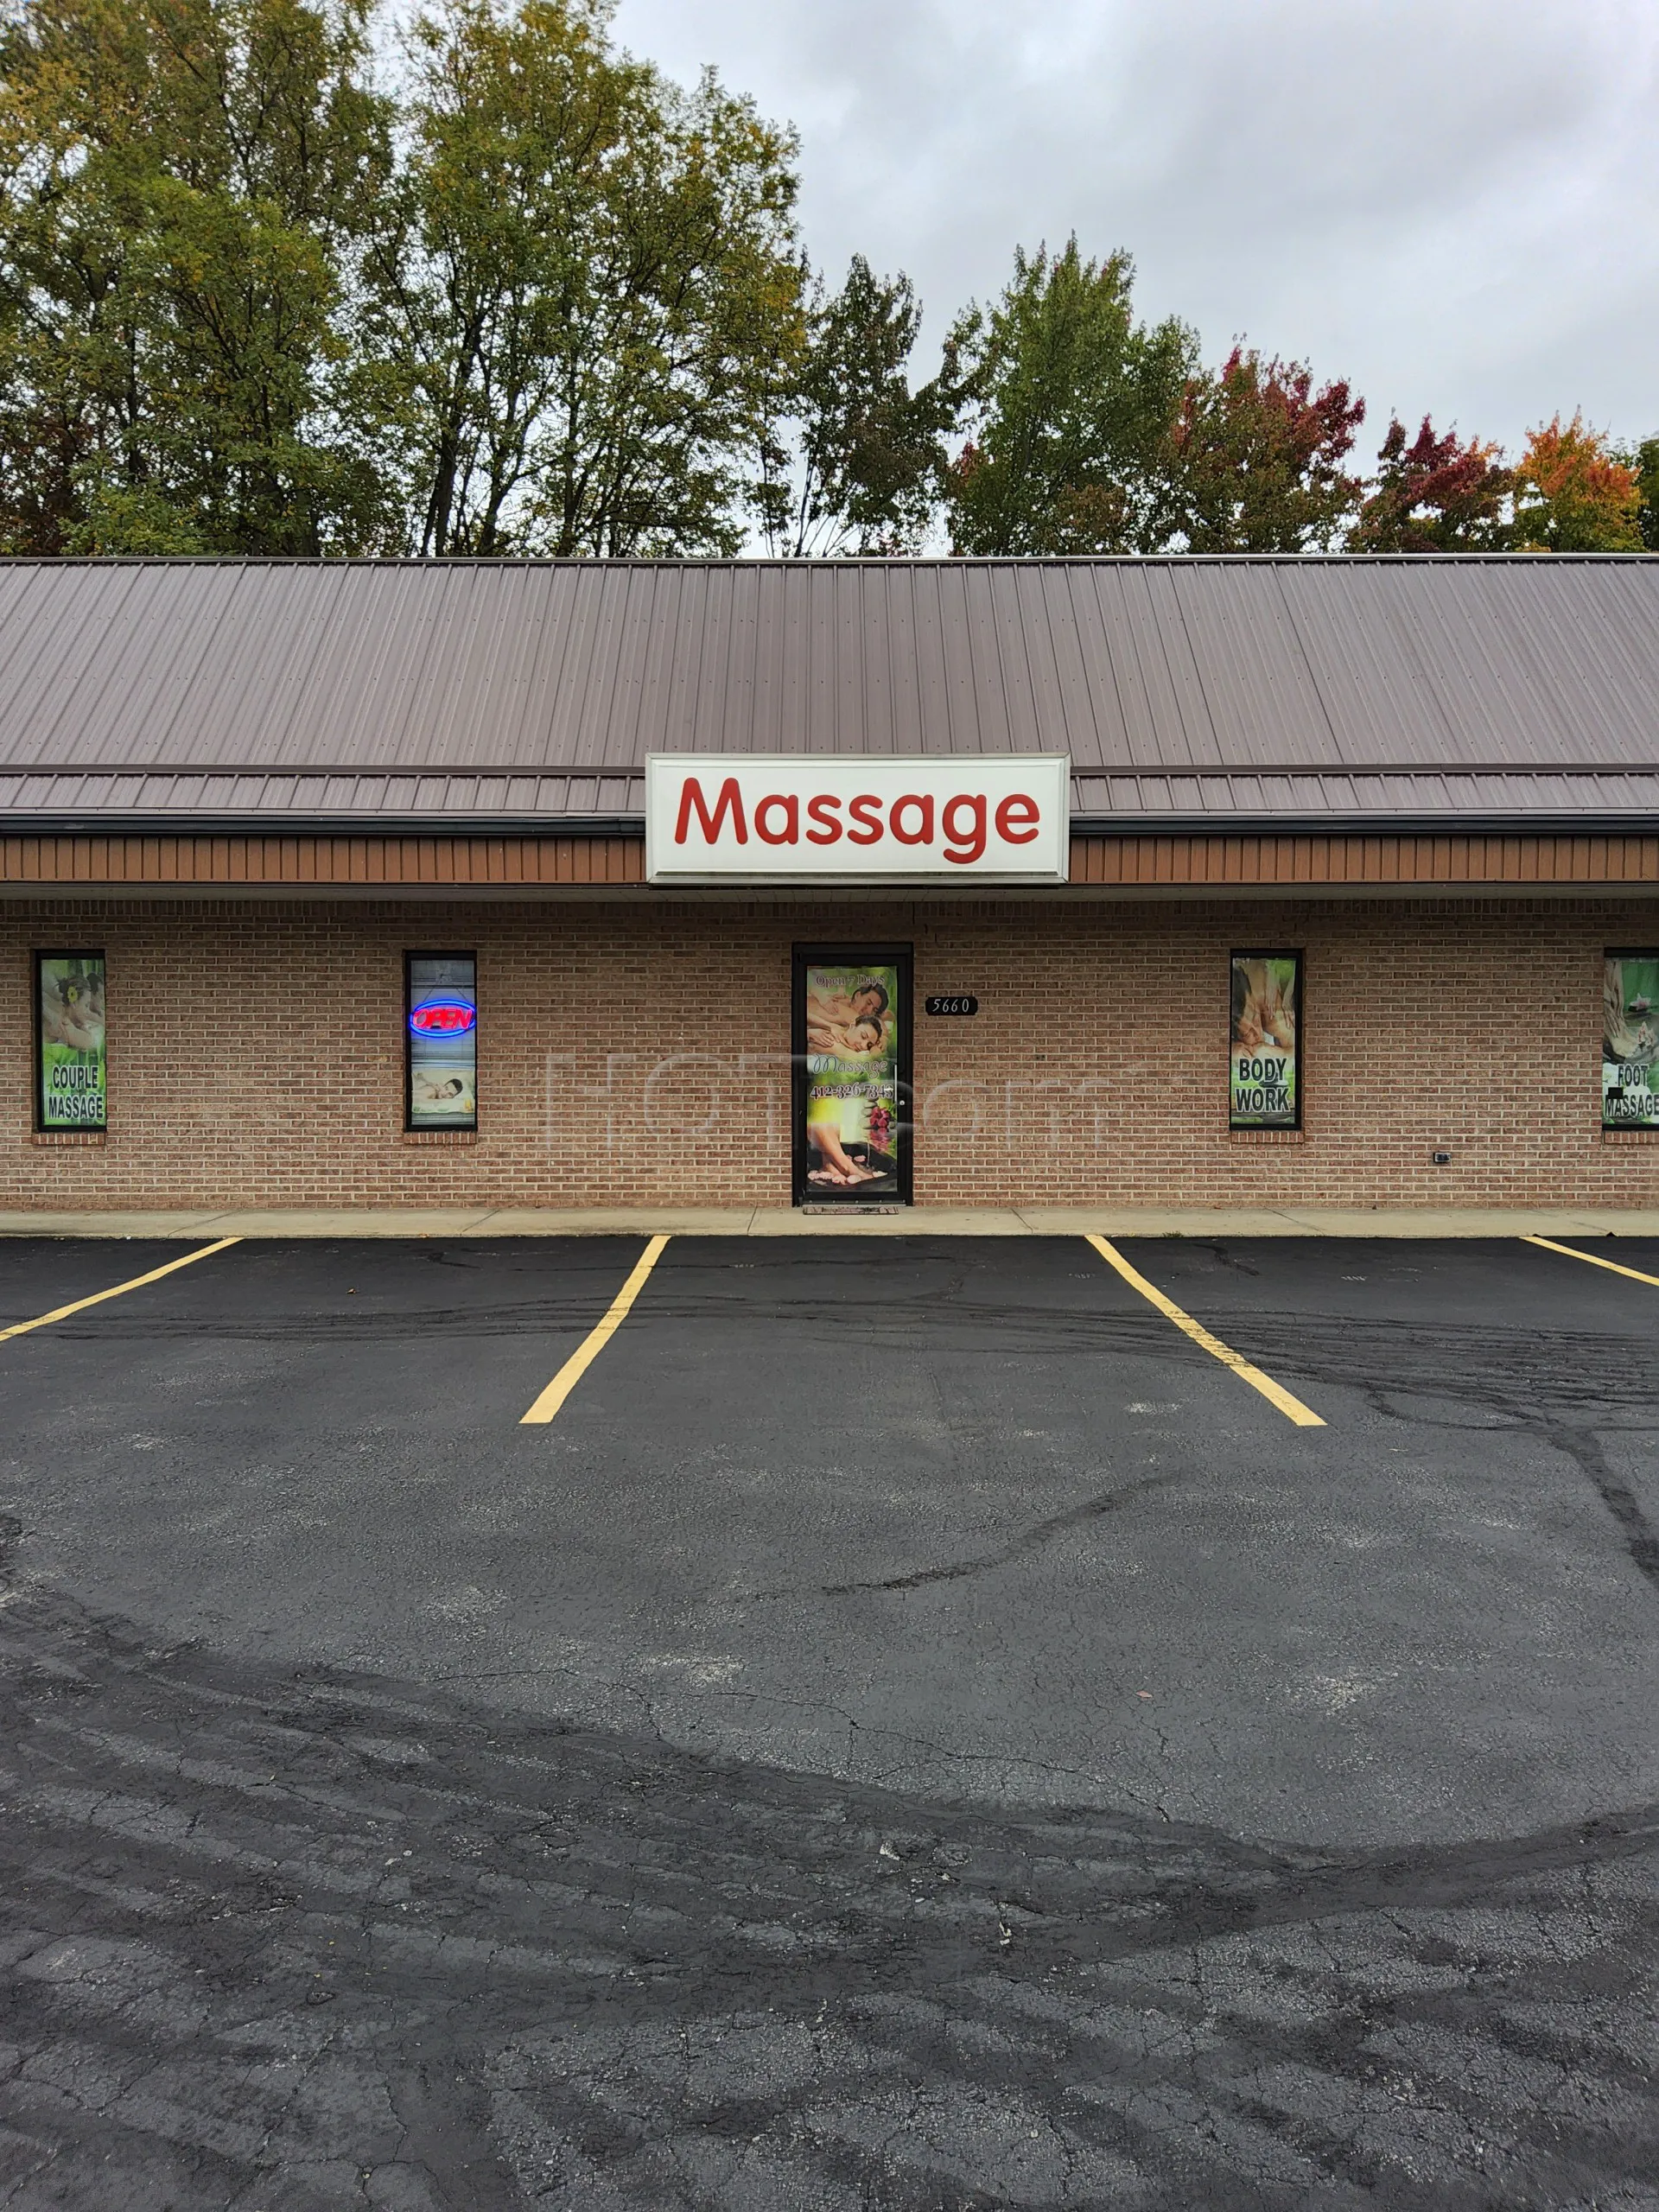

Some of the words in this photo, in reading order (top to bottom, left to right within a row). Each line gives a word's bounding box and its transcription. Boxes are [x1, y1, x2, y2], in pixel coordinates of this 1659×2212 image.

[674, 777, 1040, 865] Massage
[815, 975, 846, 988] Open
[847, 976, 856, 988] 7
[856, 974, 885, 987] Days
[932, 998, 969, 1013] 5660
[413, 1008, 473, 1029] OPEN
[53, 1065, 99, 1089] COUPLE
[813, 1053, 888, 1079] Massage
[1238, 1058, 1287, 1082] BODY
[1618, 1064, 1649, 1087] FOOT
[48, 1096, 104, 1119] MASSAGE
[1235, 1087, 1291, 1113] WORK
[1605, 1094, 1659, 1117] MASSAGE
